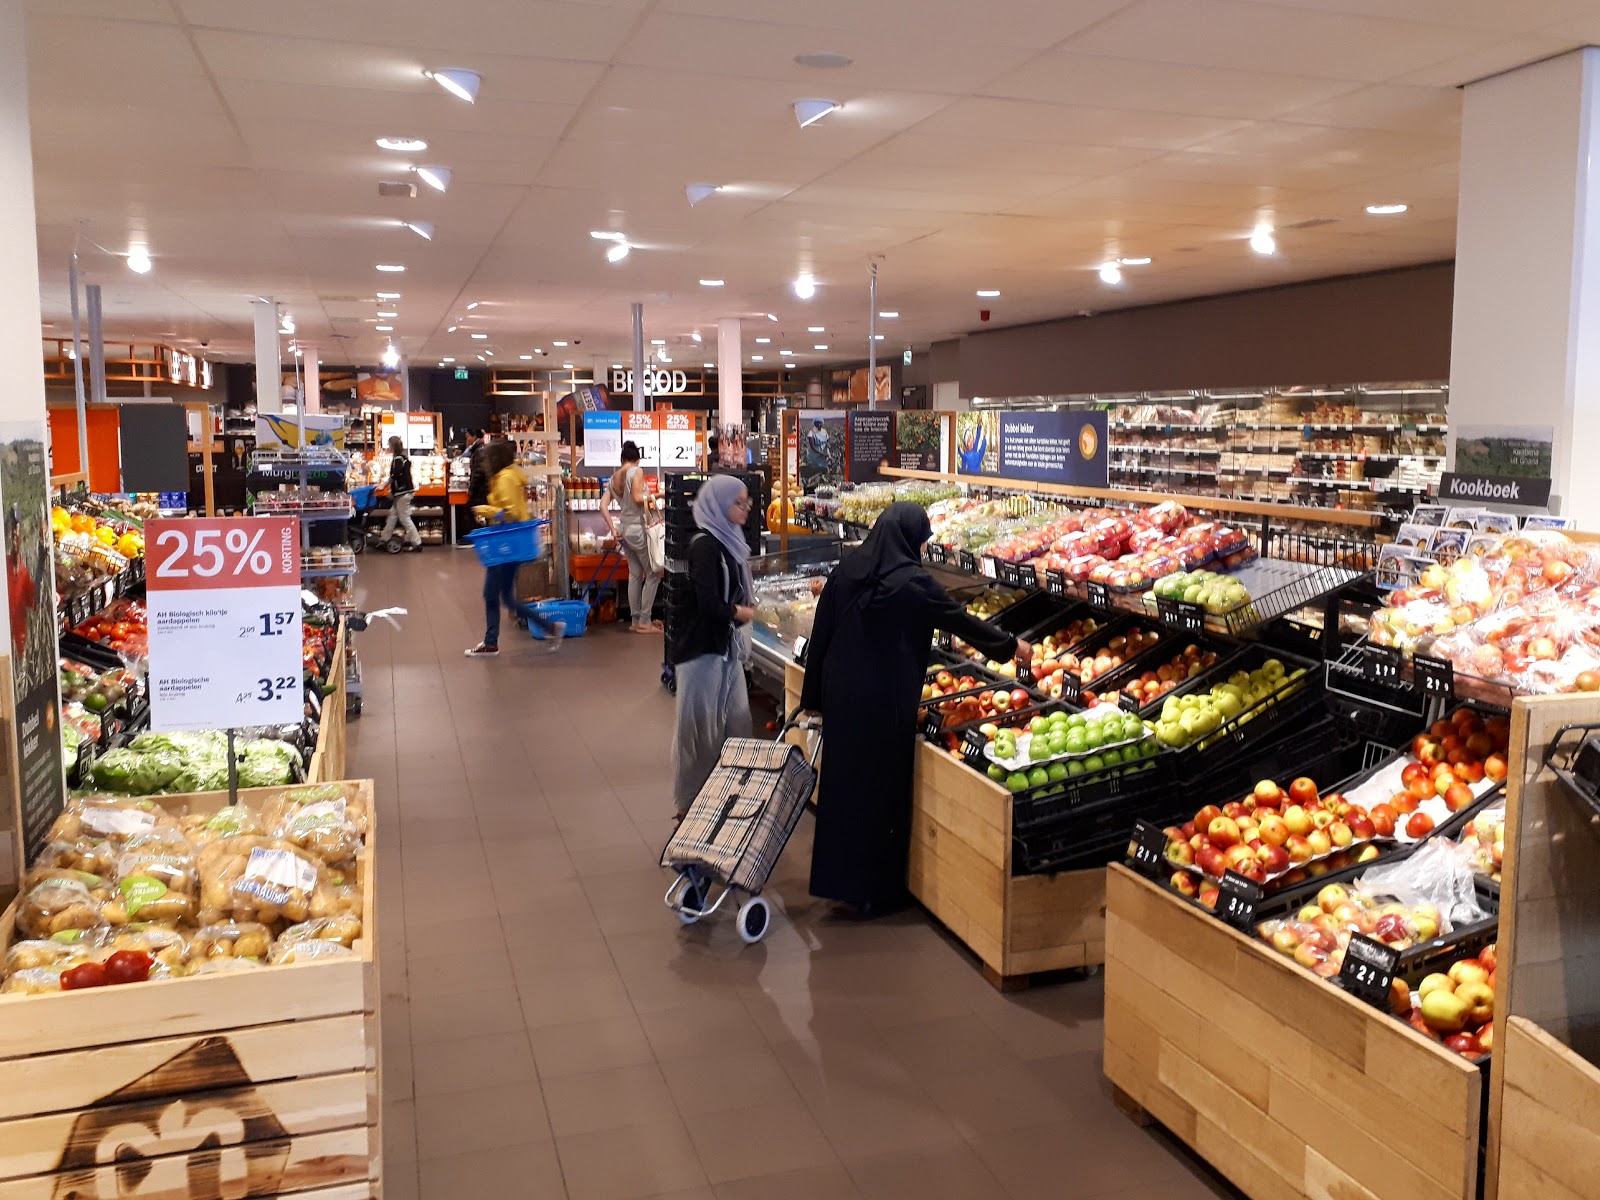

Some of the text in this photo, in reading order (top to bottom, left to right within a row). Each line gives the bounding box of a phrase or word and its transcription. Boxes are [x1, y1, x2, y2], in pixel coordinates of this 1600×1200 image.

[628, 414, 652, 424] 25%
[666, 414, 689, 424] 25%
[1450, 478, 1519, 500] Kookboek
[156, 528, 272, 578] 25%
[281, 527, 292, 574] KORTING
[169, 610, 204, 618] Biologisch
[157, 617, 200, 625] aardappelen
[171, 677, 210, 685] Biologische
[159, 684, 202, 692] aardappelen
